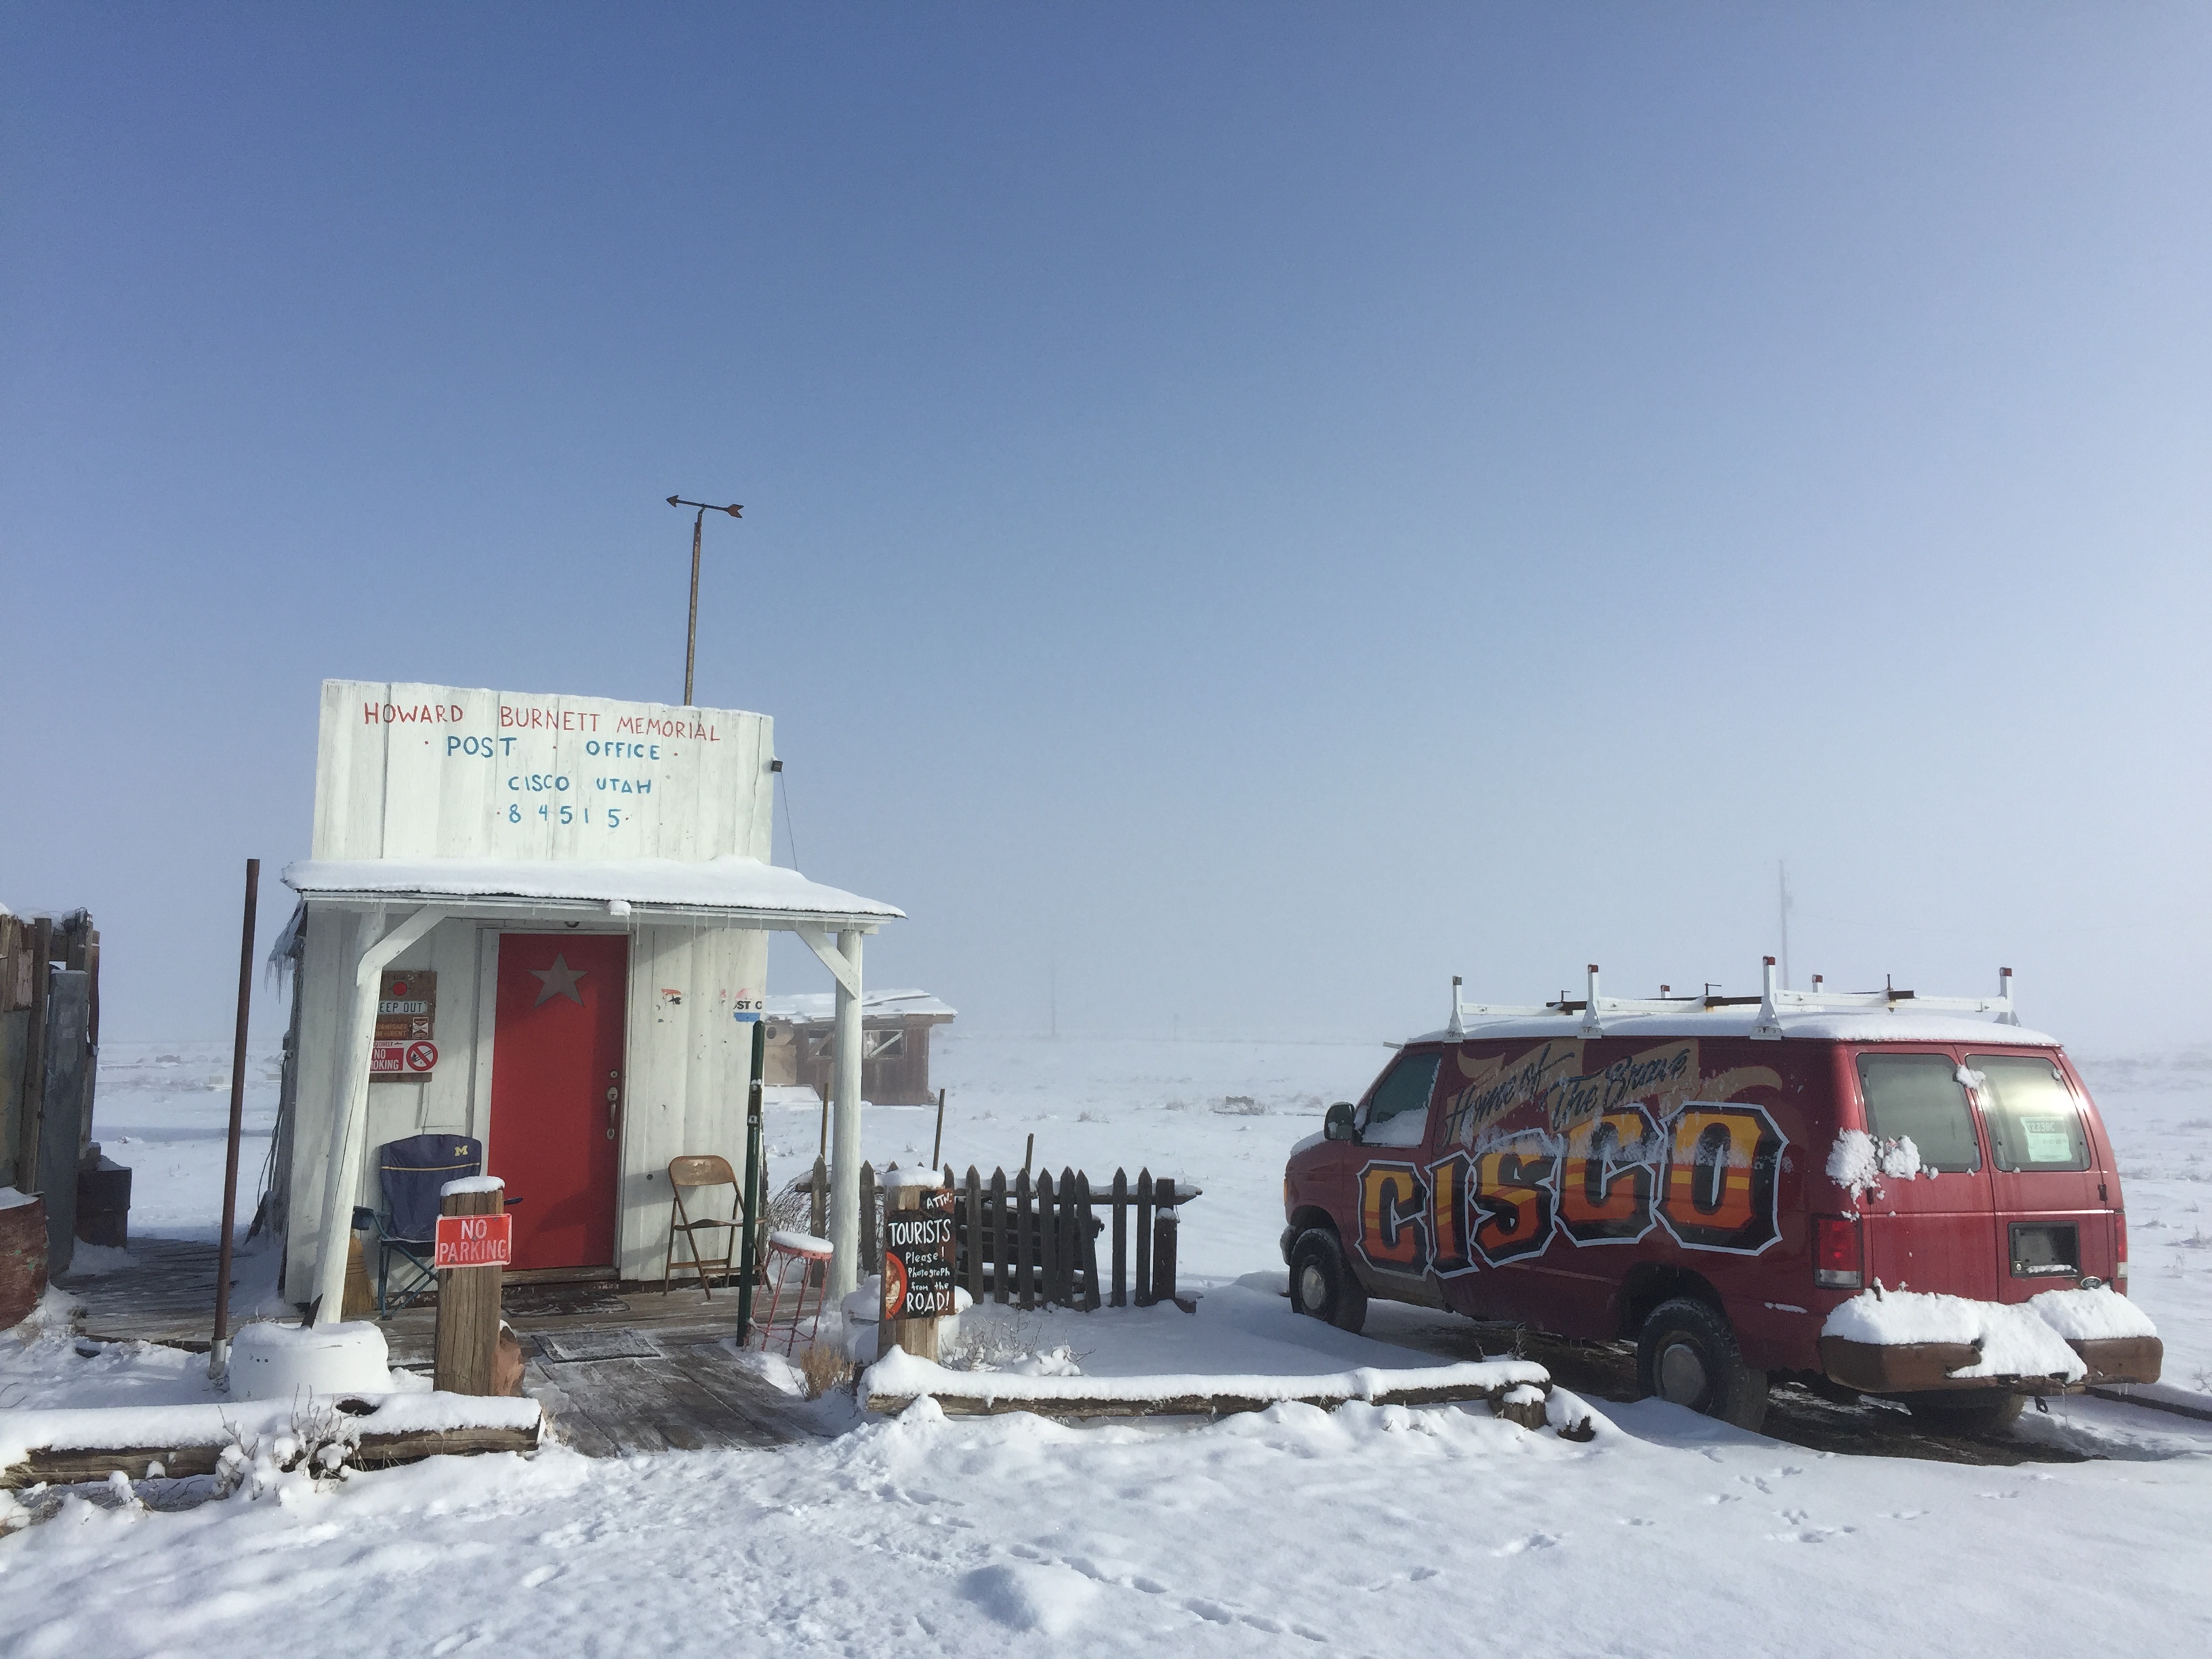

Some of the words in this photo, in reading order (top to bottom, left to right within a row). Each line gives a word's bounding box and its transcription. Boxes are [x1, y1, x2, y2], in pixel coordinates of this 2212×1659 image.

[364, 701, 464, 724] HOWARD
[500, 706, 600, 733] BURNETT
[617, 716, 720, 742] MEMORIAL
[447, 736, 517, 758] POST
[586, 740, 661, 760] OFFICE
[508, 774, 569, 792] CISCO
[596, 778, 651, 794] UTAH
[380, 1002, 398, 1012] EEP
[403, 1002, 422, 1012] OUT
[371, 1059, 399, 1070] OKING
[374, 1049, 386, 1059] NO
[1441, 1074, 1517, 1149] Home
[1520, 1042, 1576, 1101] of
[1539, 1069, 1606, 1132] The
[1603, 1048, 1691, 1111] Brave
[455, 1145, 468, 1157] M
[926, 1192, 953, 1210] ATTN:
[1355, 1101, 1790, 1281] CISCO
[461, 1219, 487, 1240] NO
[888, 1218, 951, 1247] TOURISTS
[440, 1240, 506, 1262] PARKING
[911, 1281, 928, 1292] from
[934, 1282, 949, 1291] the
[906, 1291, 950, 1313] ROAD!
